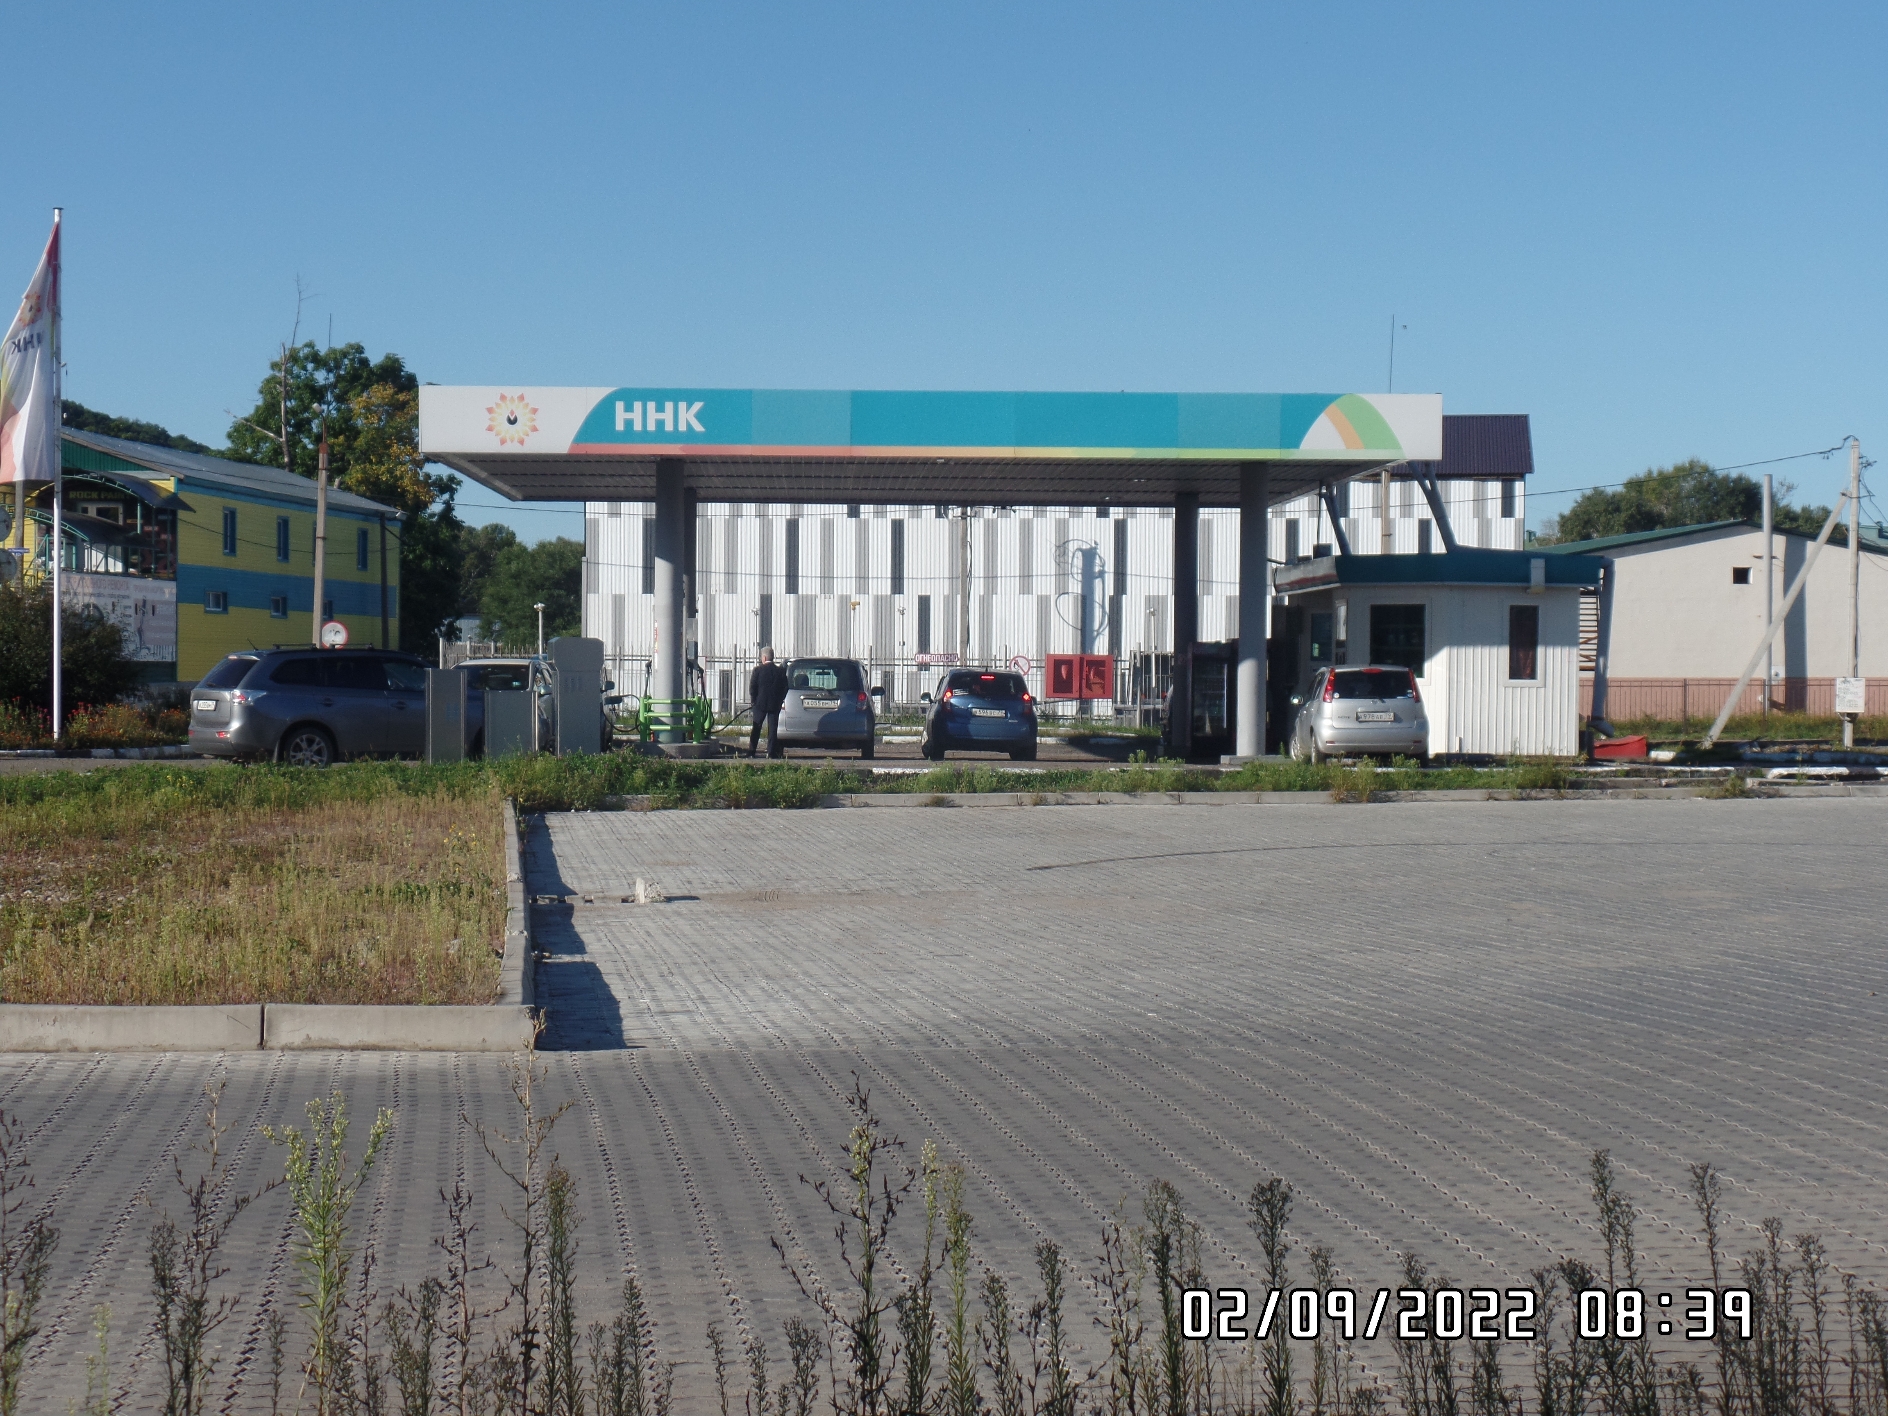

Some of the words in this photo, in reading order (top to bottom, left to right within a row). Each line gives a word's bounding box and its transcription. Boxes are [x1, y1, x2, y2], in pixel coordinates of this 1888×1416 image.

[615, 401, 705, 432] ННК
[69, 490, 99, 499] ROCK
[915, 653, 958, 662] ОГНЕОПАСНО
